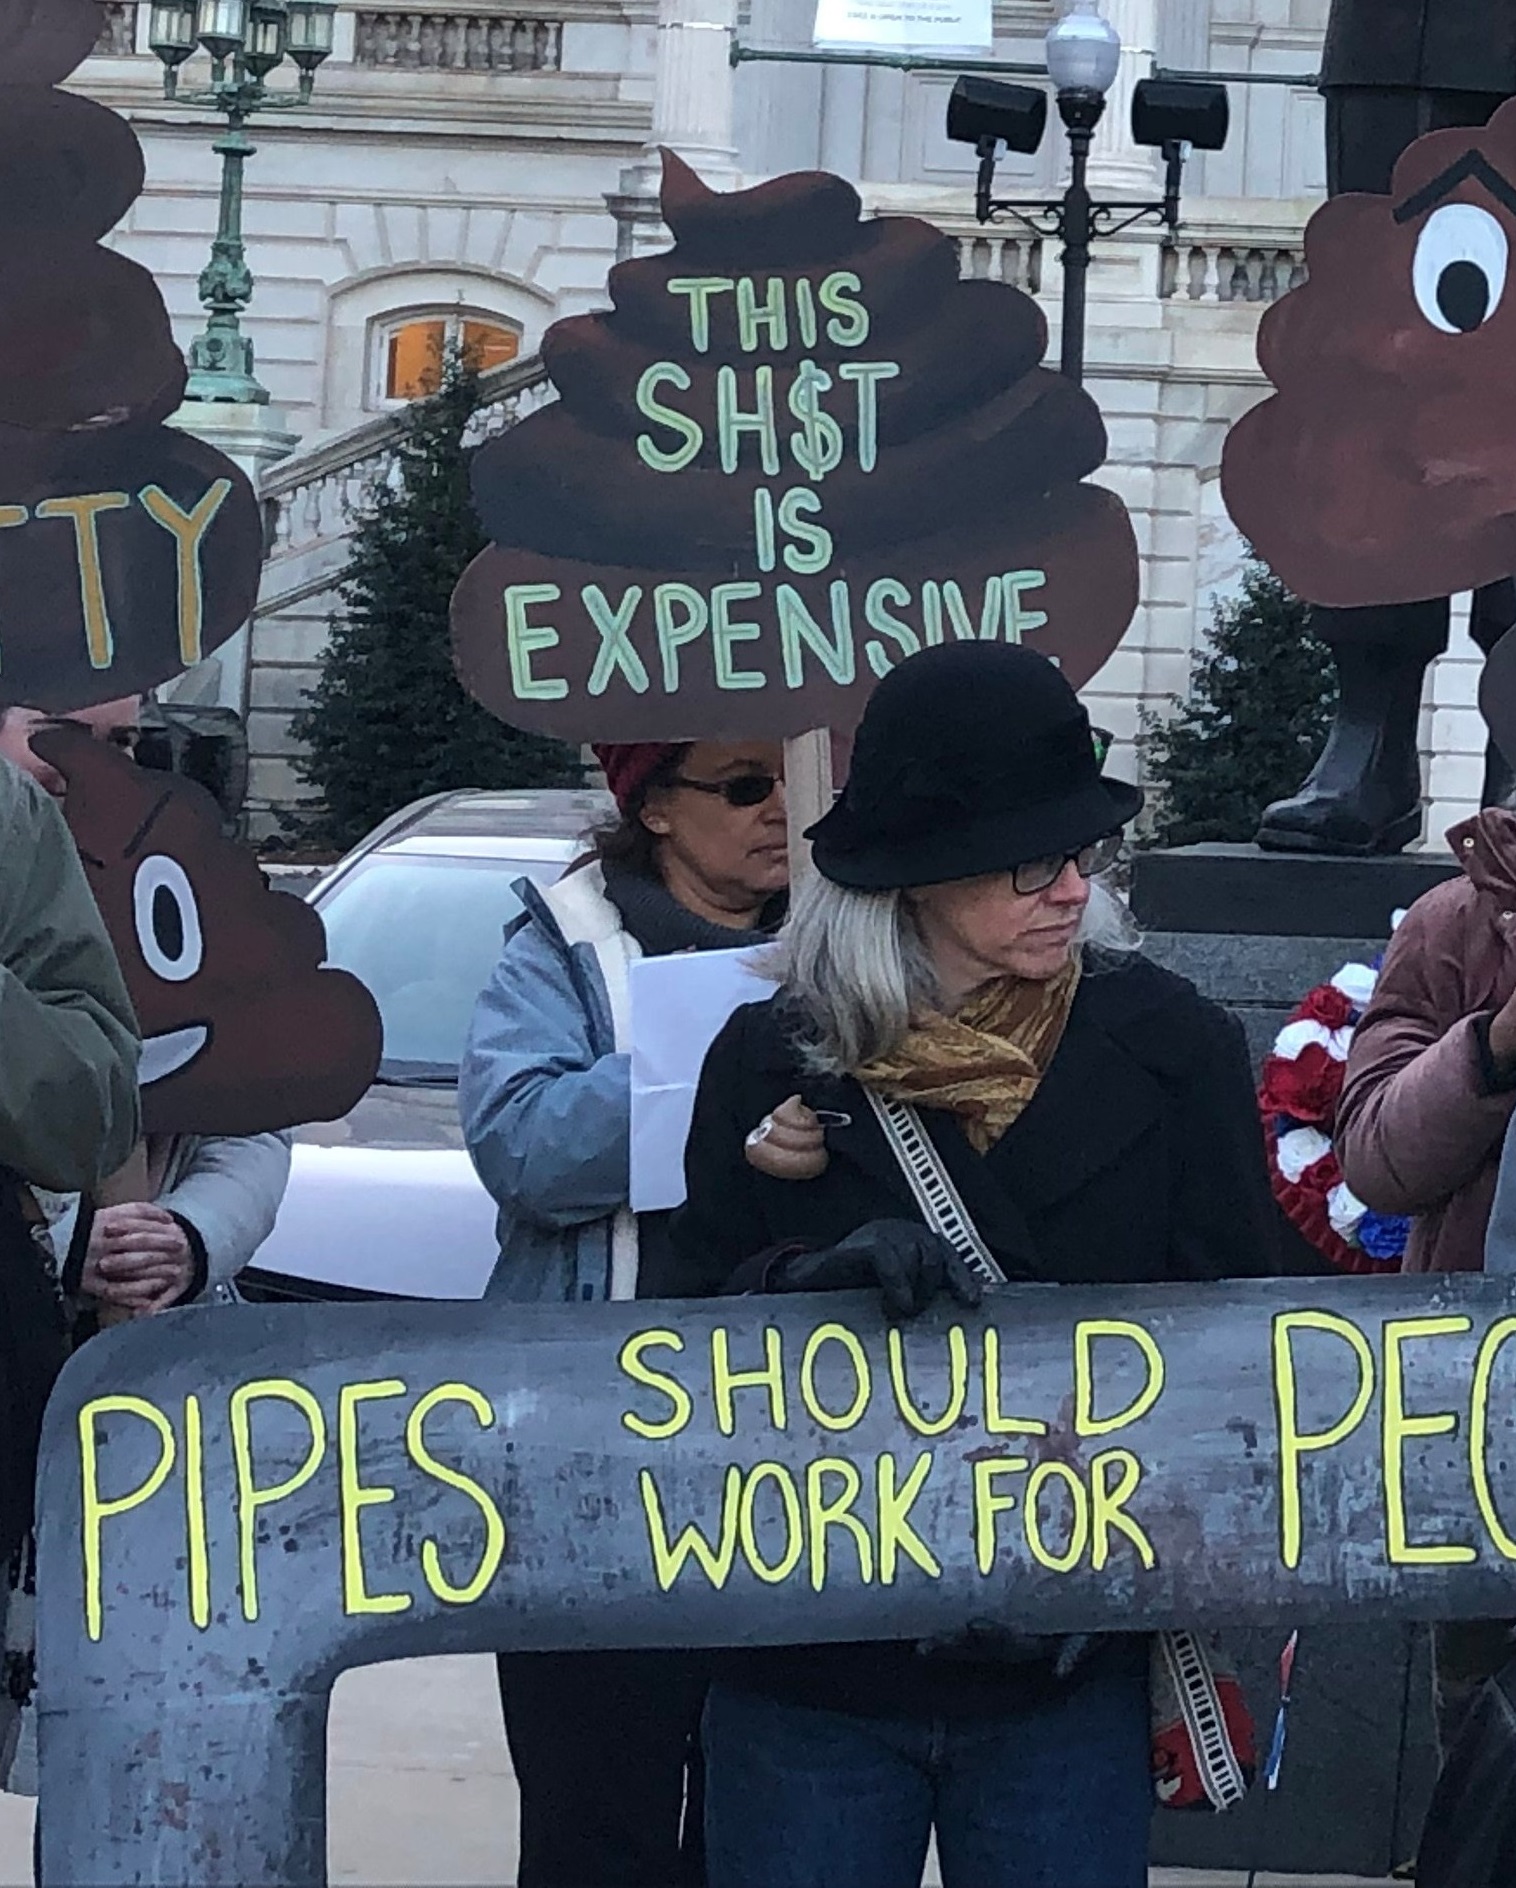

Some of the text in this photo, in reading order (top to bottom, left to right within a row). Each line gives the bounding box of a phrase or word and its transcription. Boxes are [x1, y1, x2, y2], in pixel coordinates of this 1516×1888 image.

[667, 271, 871, 354] THIS
[635, 358, 901, 482] SH$T
[0, 477, 233, 671] TY
[752, 486, 834, 575] IS
[502, 568, 1062, 701] EXPENSIVE
[78, 1377, 505, 1643] PIPES
[618, 1320, 1167, 1440] SHOULD
[638, 1447, 1157, 1593] WORK FOR
